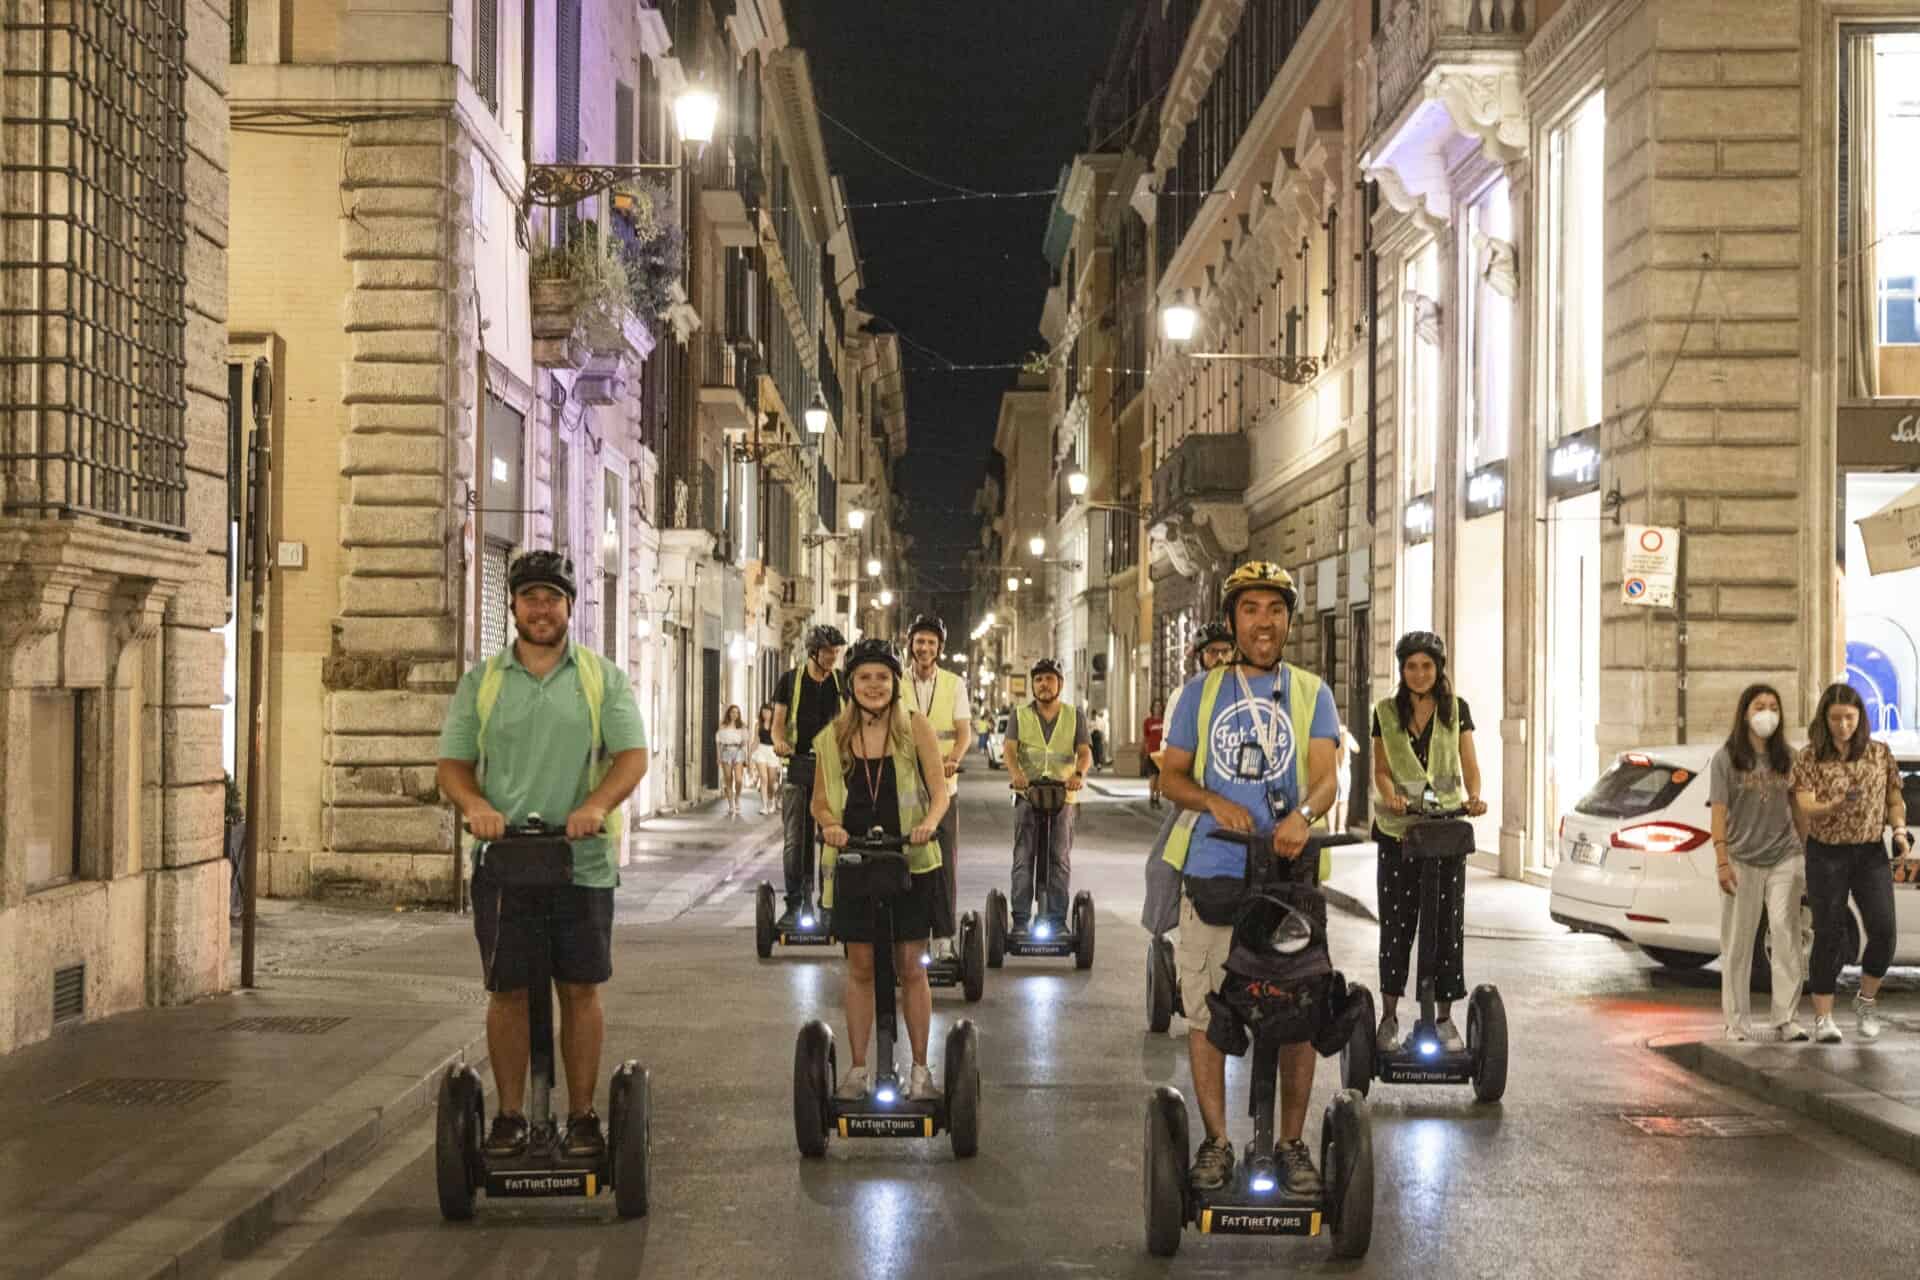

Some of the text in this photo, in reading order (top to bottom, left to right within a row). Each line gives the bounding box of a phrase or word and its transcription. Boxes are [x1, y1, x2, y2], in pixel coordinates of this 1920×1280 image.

[1216, 722, 1288, 749] Fat Te
[504, 1176, 580, 1191] FATTIRETOURS
[1220, 1214, 1302, 1227] FATTIRETOURS
